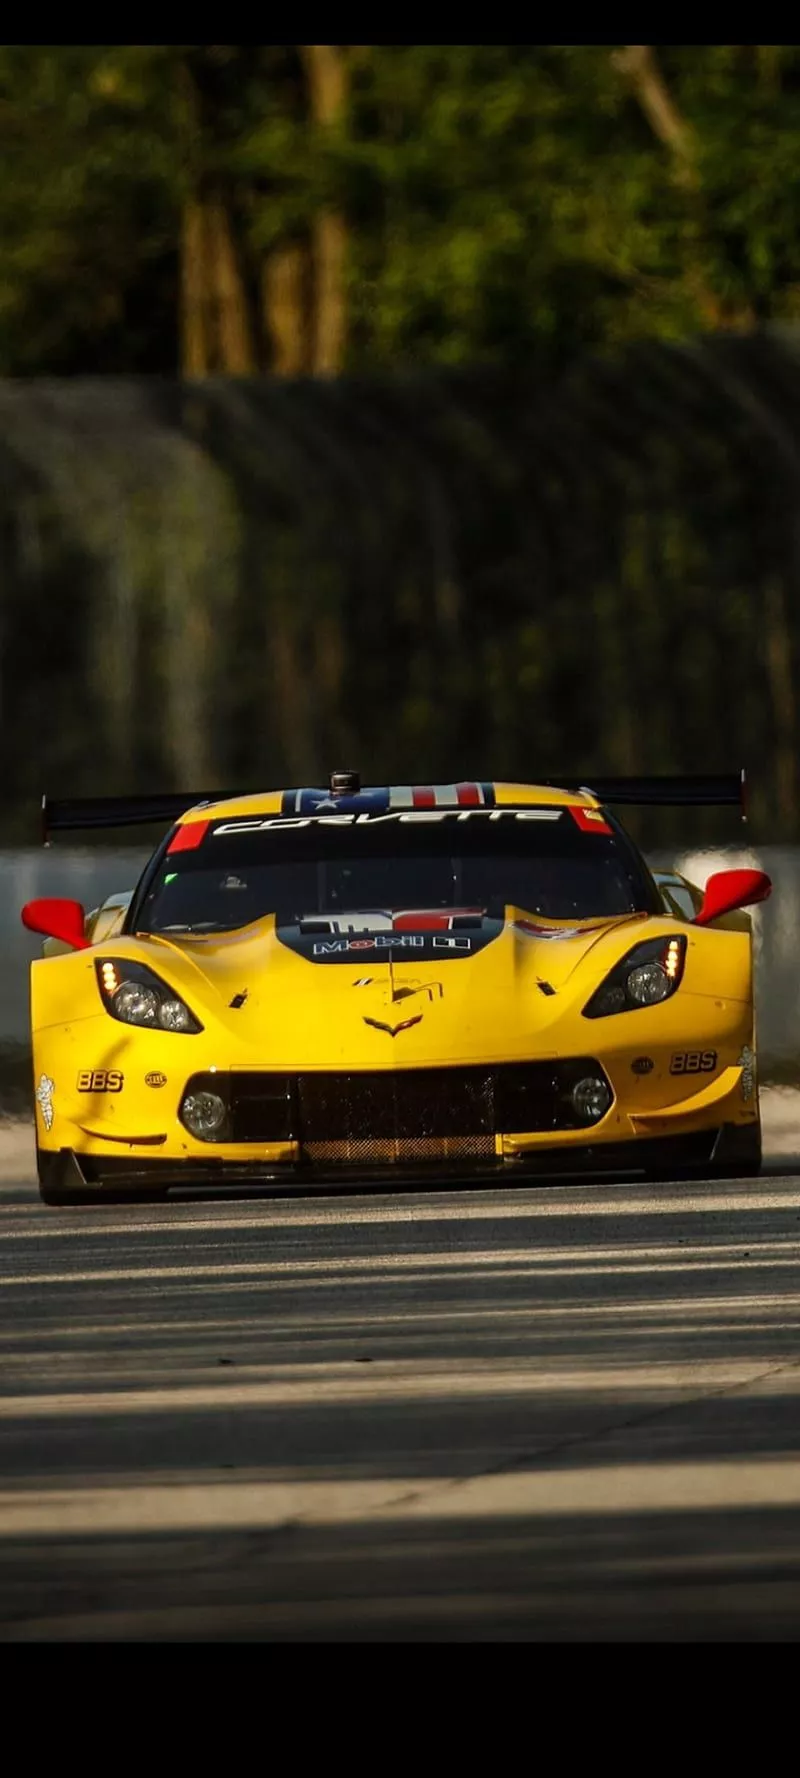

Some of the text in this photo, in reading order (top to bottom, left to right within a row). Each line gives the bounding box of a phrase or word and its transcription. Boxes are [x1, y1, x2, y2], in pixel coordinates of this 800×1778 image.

[212, 810, 563, 835] CORVETTE
[313, 936, 424, 955] Mobil
[670, 1050, 717, 1074] BBS
[77, 1069, 124, 1092] BBS
